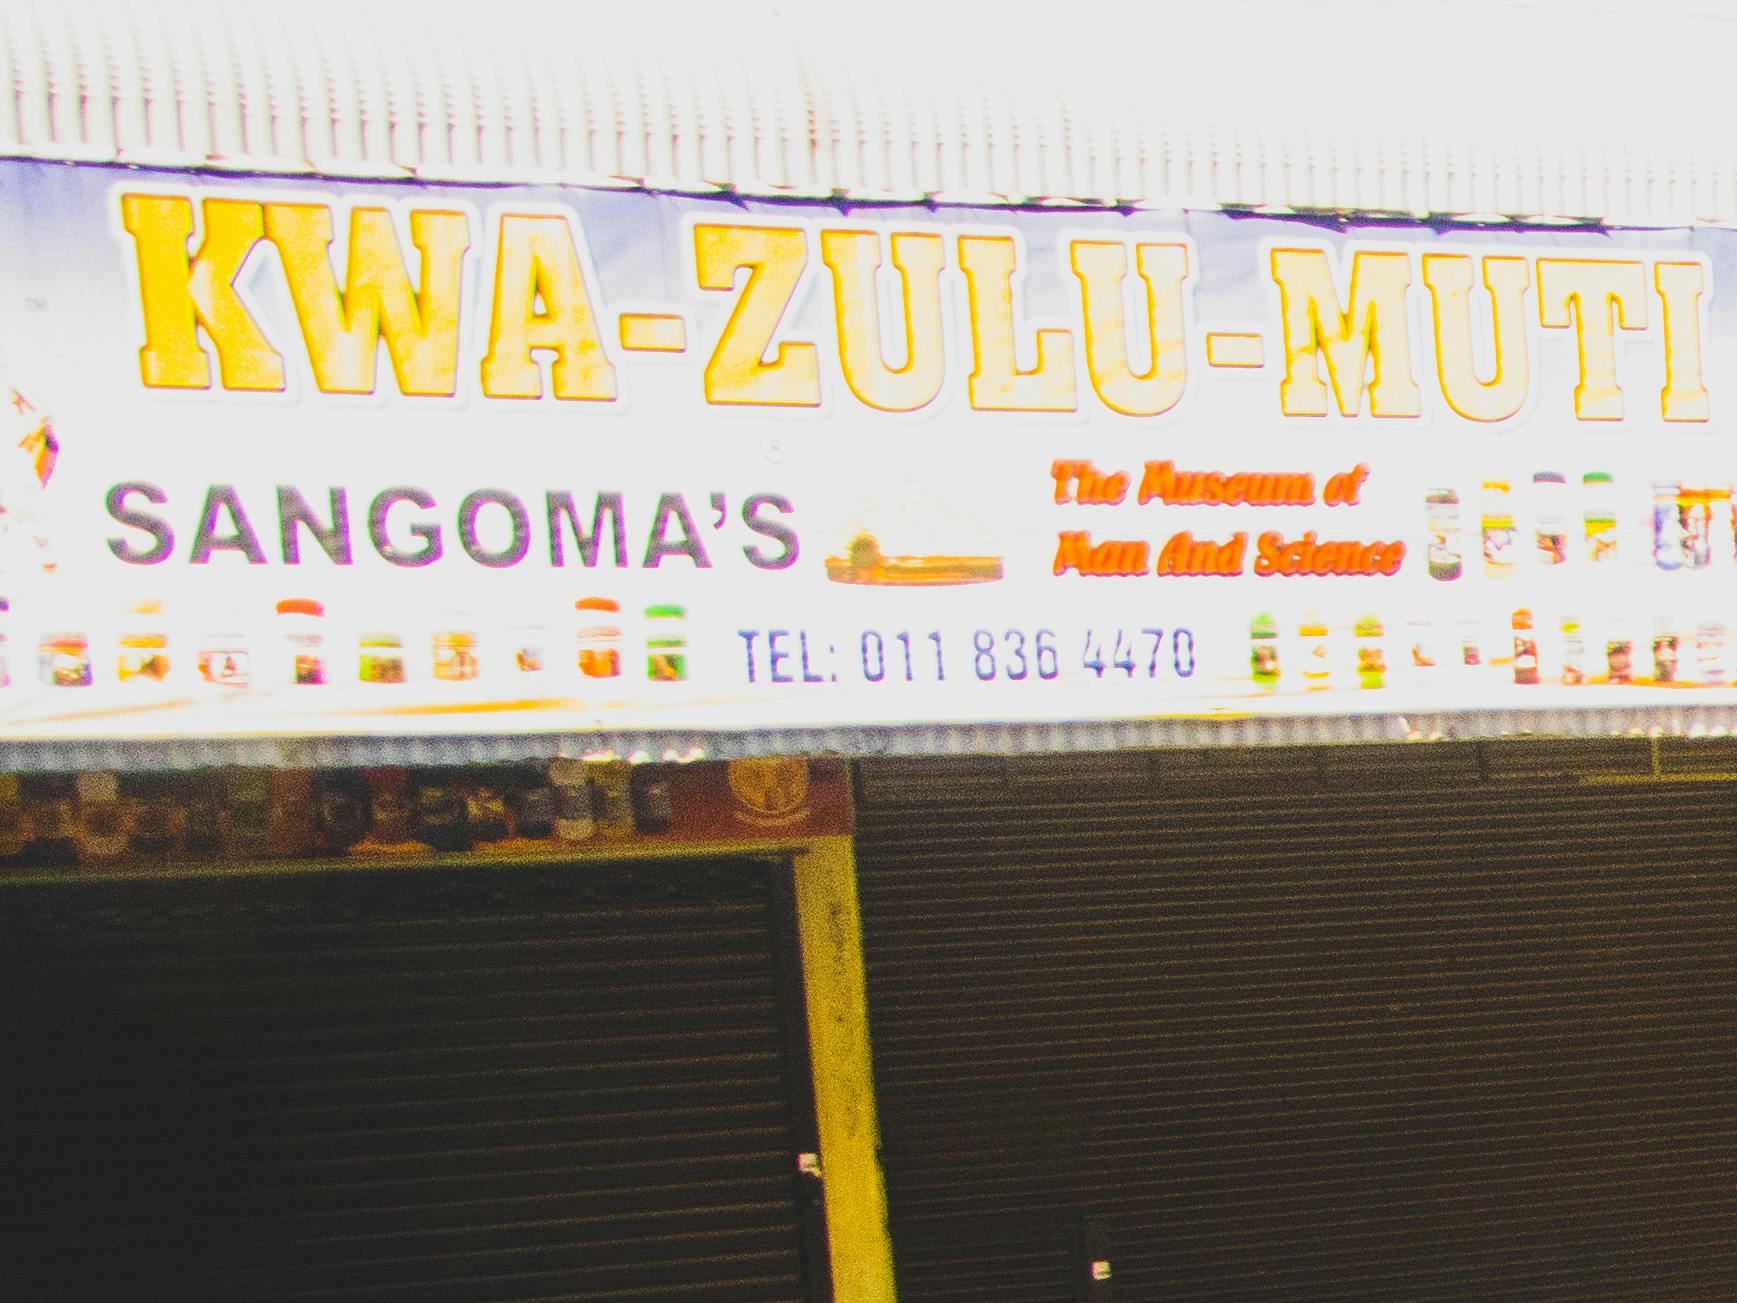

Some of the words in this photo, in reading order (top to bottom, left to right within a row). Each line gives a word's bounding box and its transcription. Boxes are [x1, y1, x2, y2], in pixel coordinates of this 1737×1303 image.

[119, 191, 1712, 424] KWA-ZULU-MUTI
[1051, 459, 1130, 505] The
[1138, 459, 1306, 506] Museum
[1312, 461, 1372, 507] of
[105, 479, 800, 569] SANGOMA'S
[1051, 532, 1151, 577] Man
[1158, 533, 1246, 577] And
[1251, 534, 1405, 578] Science
[738, 629, 837, 684] TEL:
[861, 630, 948, 683] 011
[972, 630, 1058, 682] 836
[1082, 627, 1196, 679] 4470
